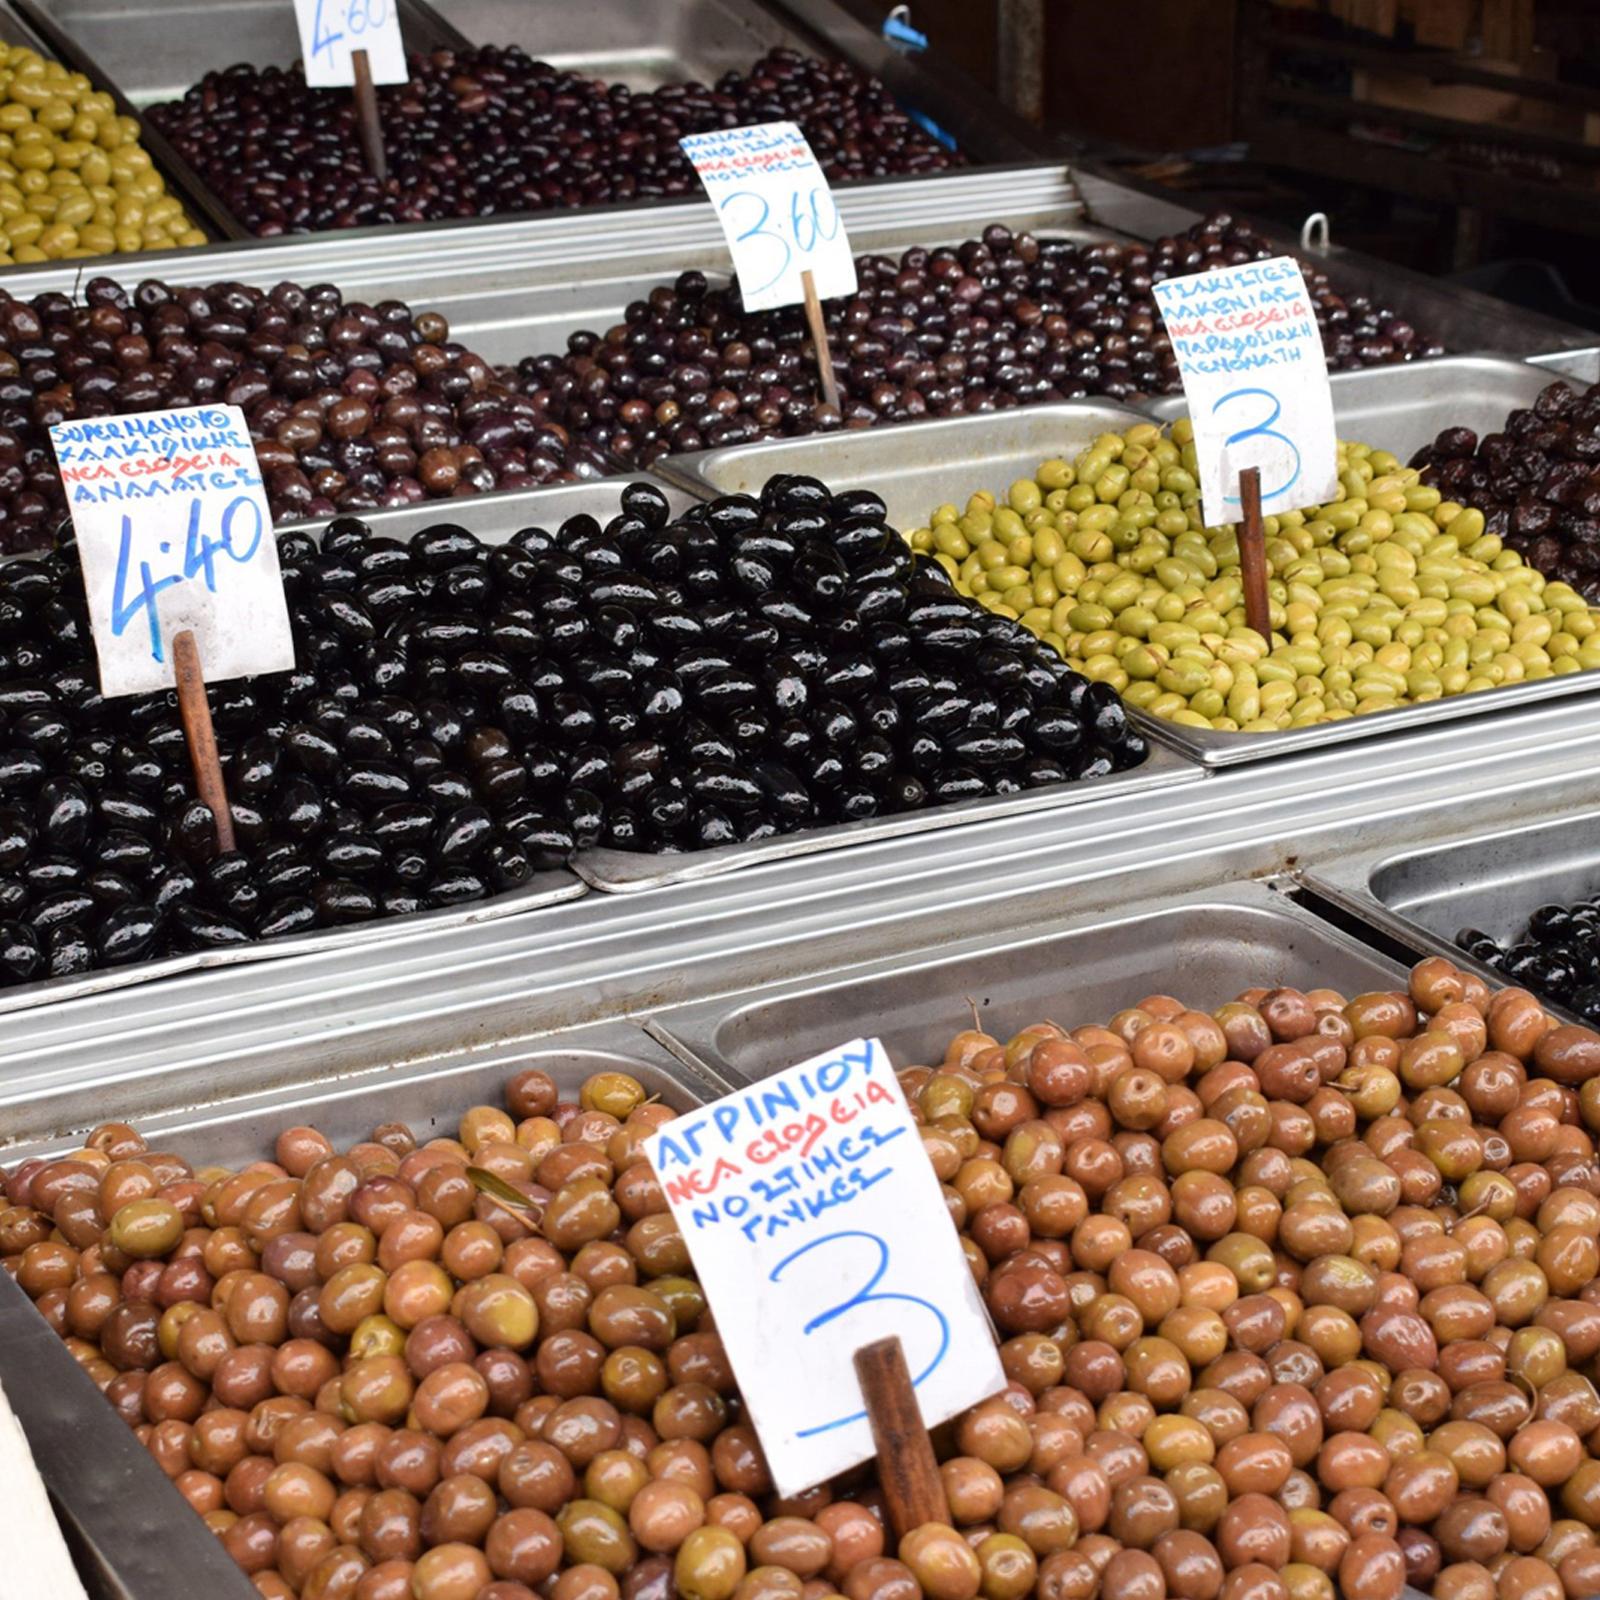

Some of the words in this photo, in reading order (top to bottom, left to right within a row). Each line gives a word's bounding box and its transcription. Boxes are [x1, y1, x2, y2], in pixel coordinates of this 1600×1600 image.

[1212, 388, 1301, 504] 3
[657, 1039, 874, 1171] ΑΓΡΙΝΙΟΥ
[769, 1230, 950, 1437] 3
